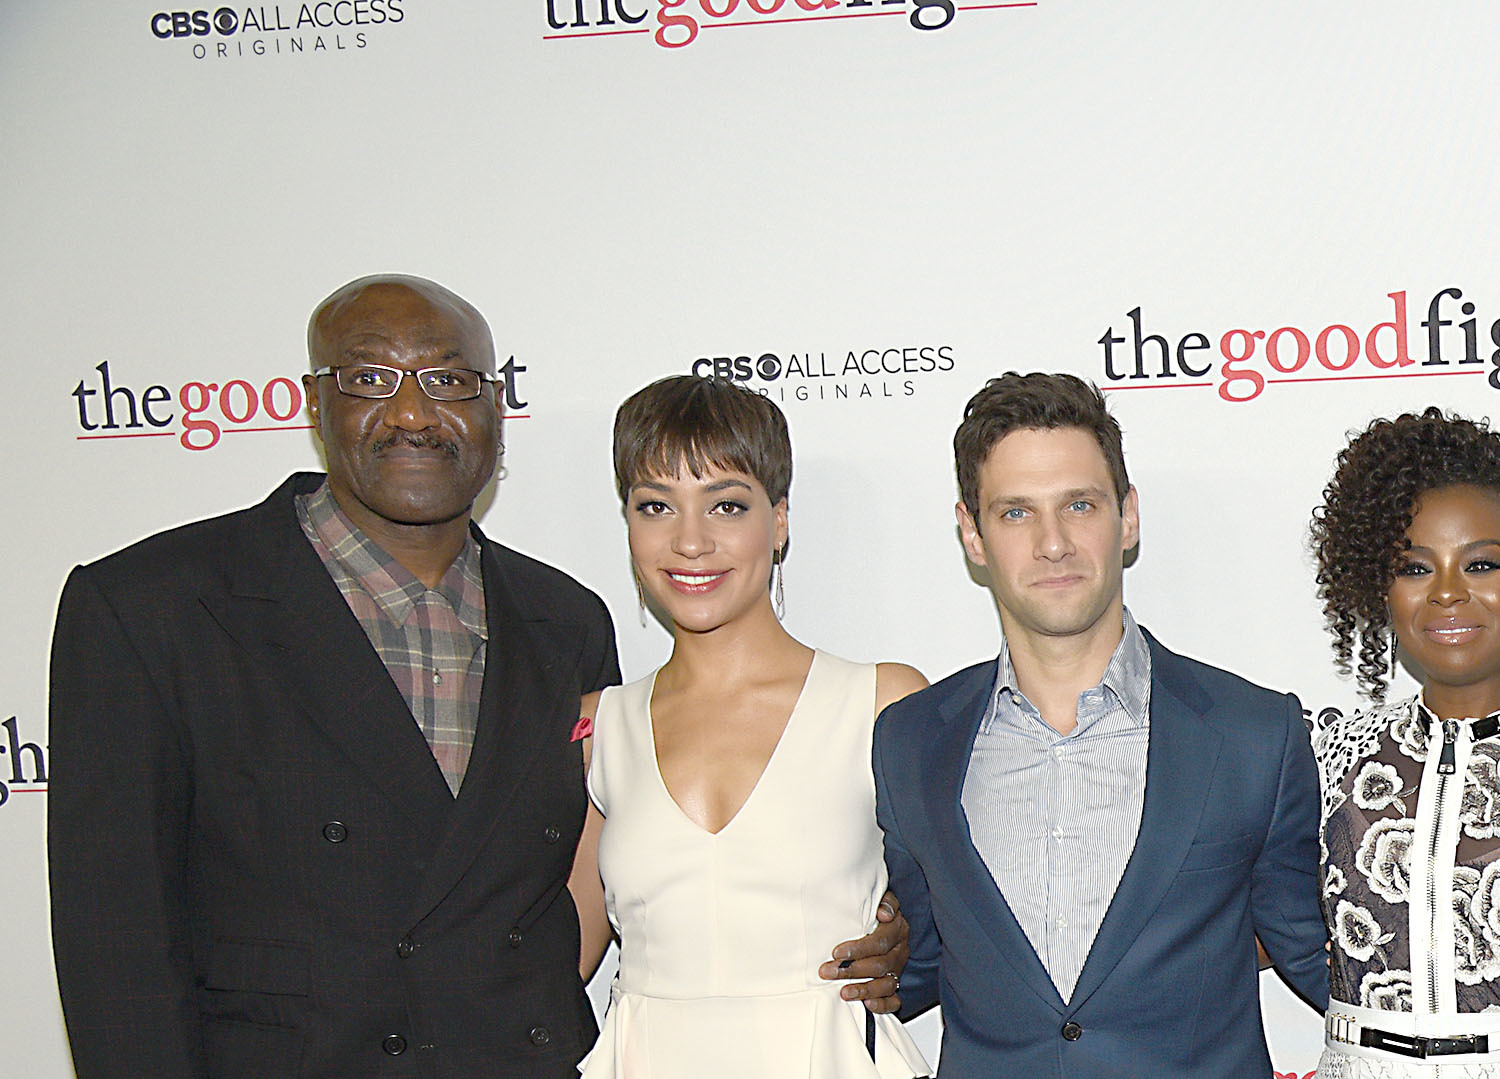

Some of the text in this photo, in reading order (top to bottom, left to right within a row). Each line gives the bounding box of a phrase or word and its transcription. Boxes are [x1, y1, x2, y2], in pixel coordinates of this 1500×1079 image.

[242, 6, 290, 33] ALL
[297, 0, 404, 29] ACCESS
[193, 33, 367, 59] ORIGINALS
[785, 353, 836, 379] ALL
[842, 346, 954, 375] ACCESS
[759, 381, 915, 401] RIGINALS
